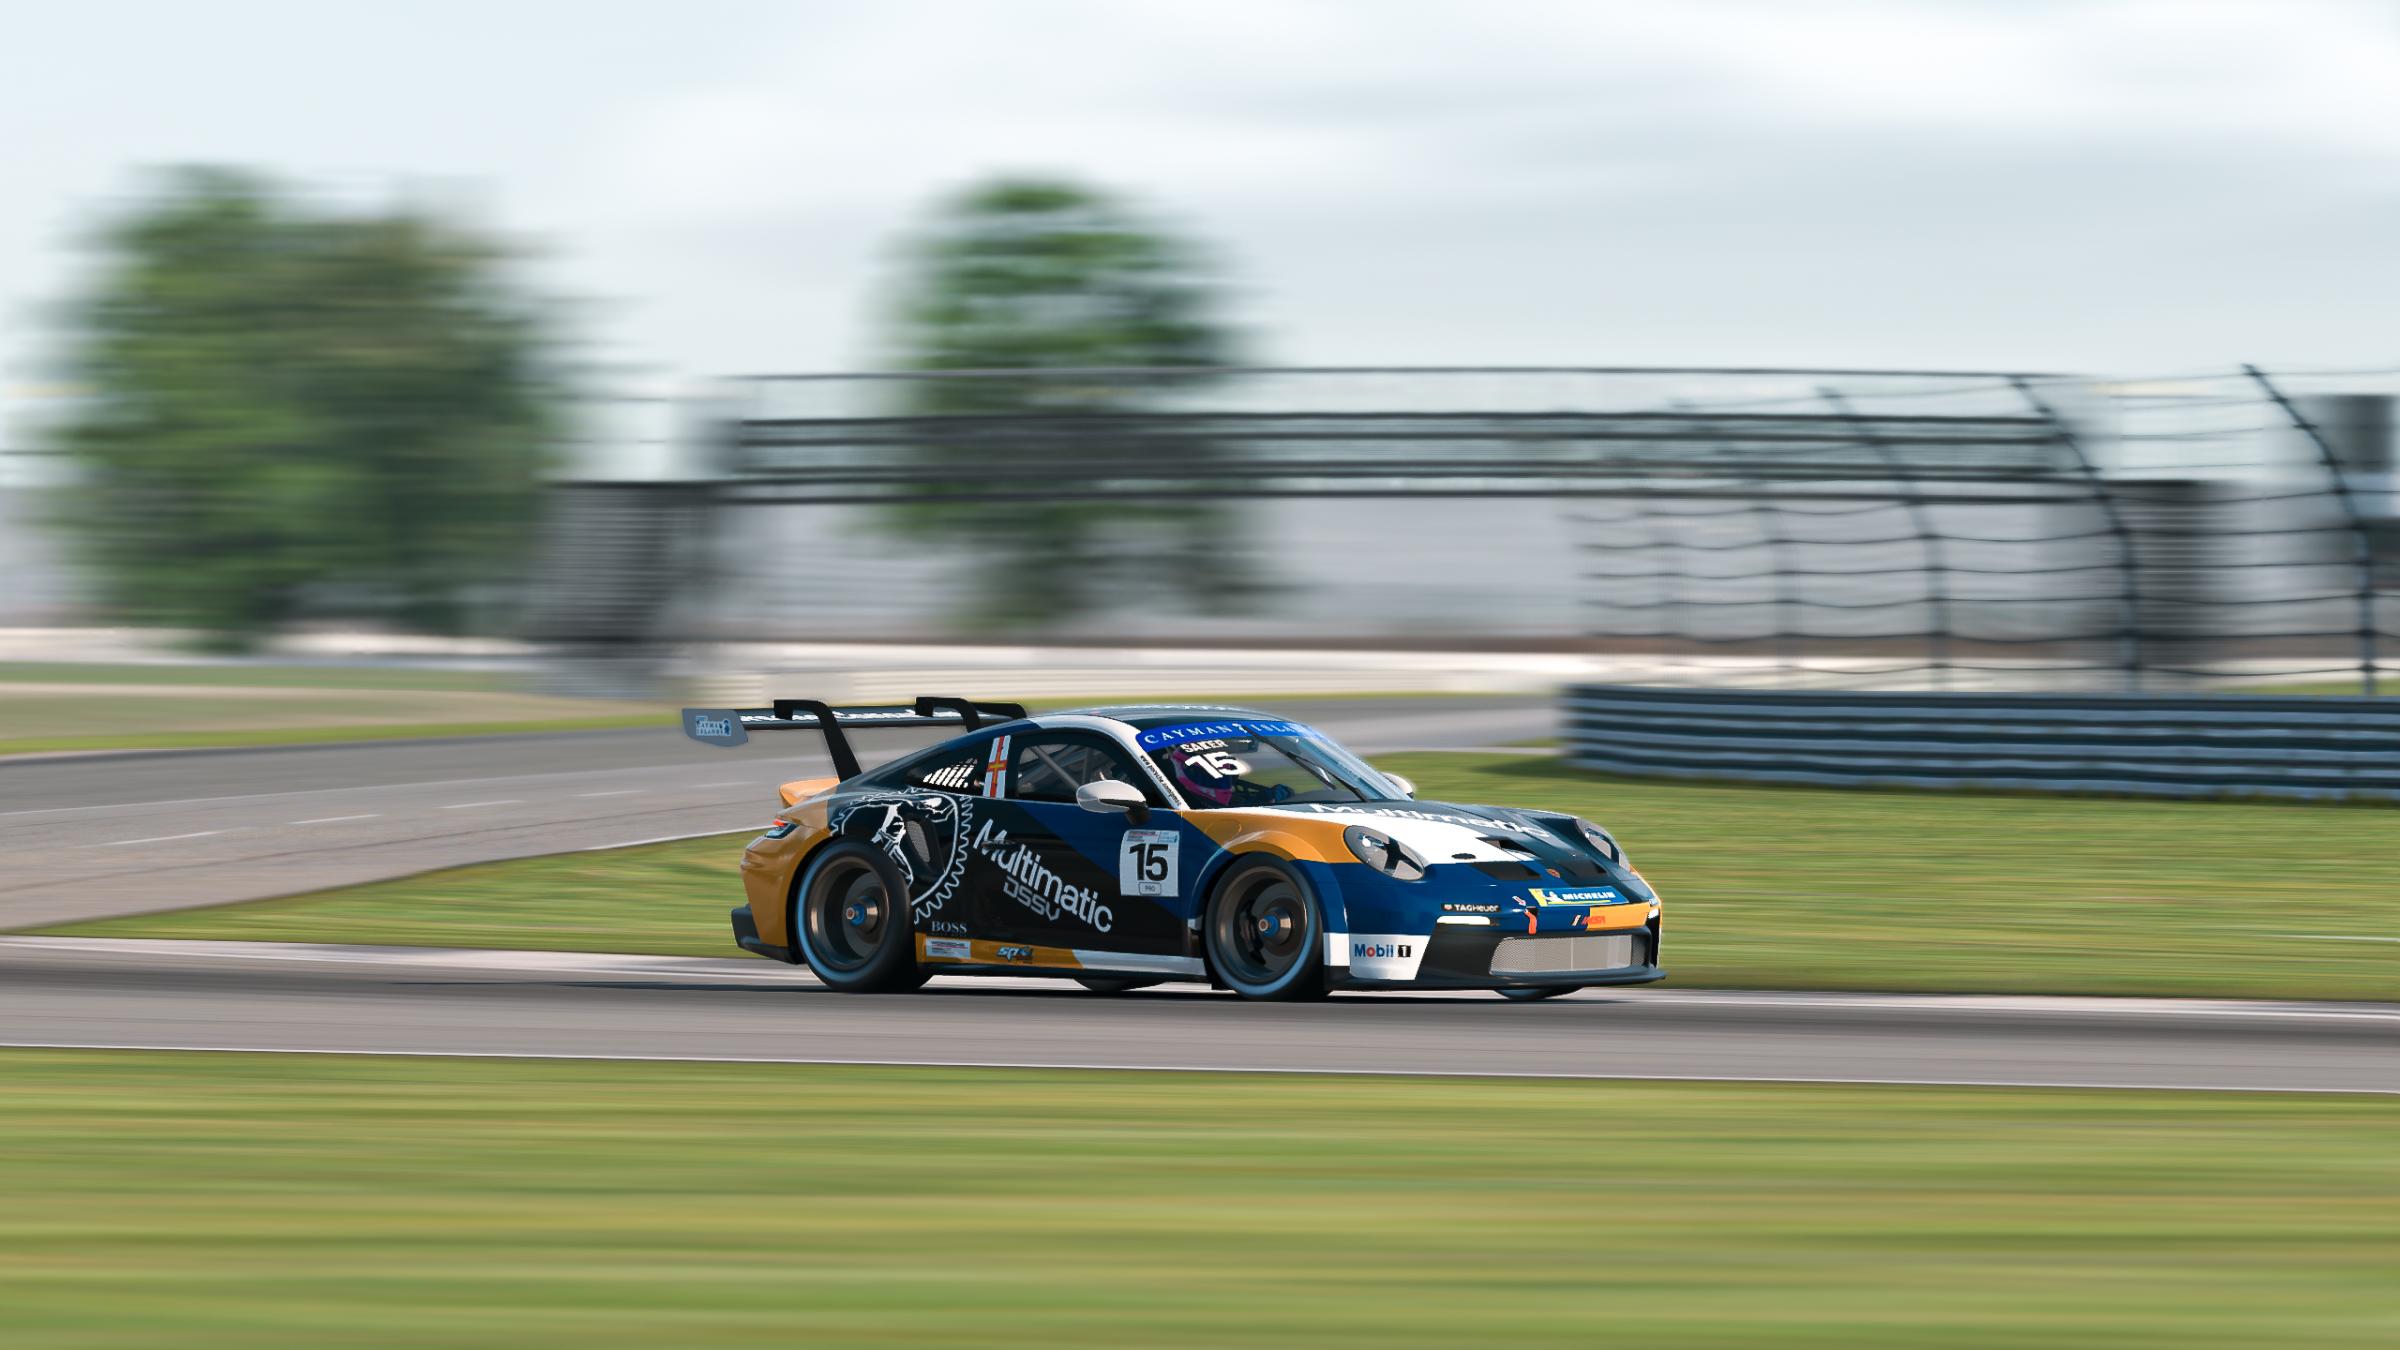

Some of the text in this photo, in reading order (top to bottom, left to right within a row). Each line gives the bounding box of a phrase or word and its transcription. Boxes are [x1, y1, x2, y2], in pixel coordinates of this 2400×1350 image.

[1144, 724, 1232, 745] CAYMAN
[1184, 751, 1249, 779] 15
[1308, 803, 1550, 838] Multimatic
[973, 818, 1113, 933] Multimatic
[1129, 843, 1169, 882] 15
[1003, 875, 1061, 921] DSSV
[1561, 891, 1617, 900] MICHELIN
[931, 920, 968, 933] BOSS
[1354, 943, 1394, 957] Mobil
